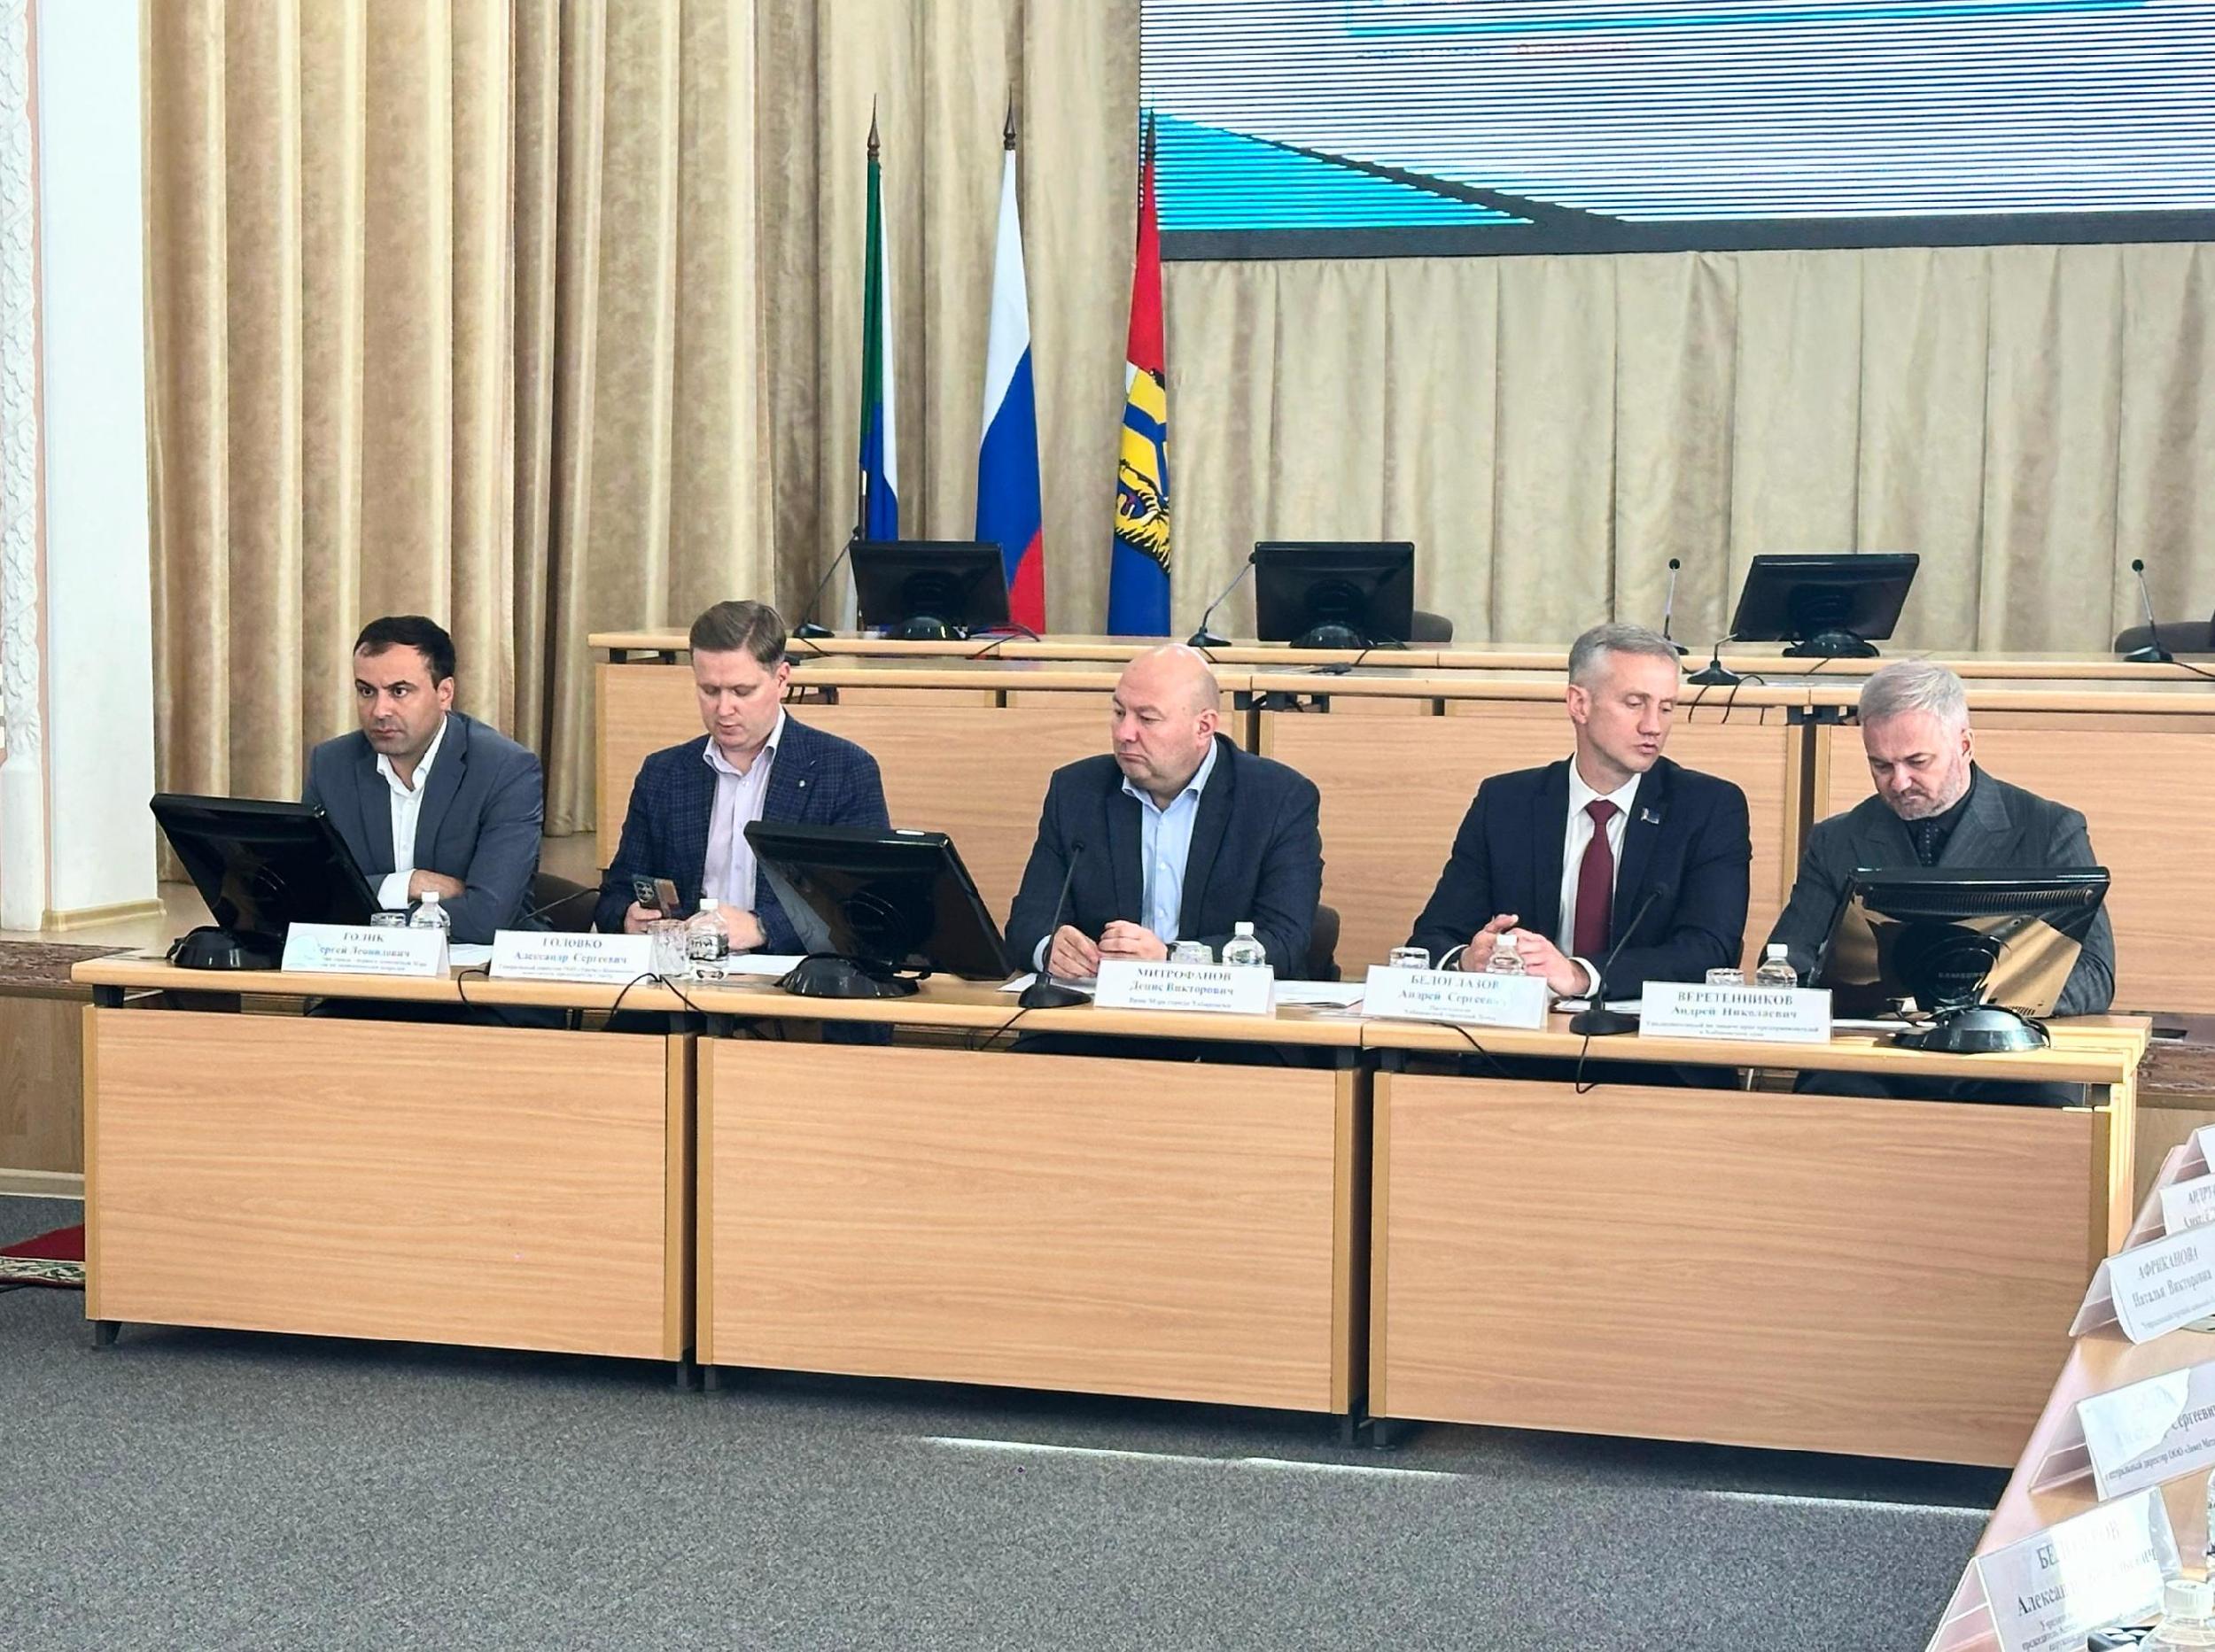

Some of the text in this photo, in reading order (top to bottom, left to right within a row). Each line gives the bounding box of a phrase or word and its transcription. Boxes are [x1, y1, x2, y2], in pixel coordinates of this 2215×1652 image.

[318, 944, 347, 956] ергей
[542, 937, 603, 949] ГОЛОВКО
[1137, 967, 1232, 982] МИТРОФАНОВ
[1411, 974, 1501, 990] БЕЛОГЛАЗОВ
[1129, 980, 1234, 997] Денис Викторович
[1398, 989, 1442, 1003] Андрей
[1677, 991, 1794, 1006] ВЕРЕТЕННИКОВ
[1671, 1005, 1798, 1020] Андрей Николаевич
[2138, 1245, 2198, 1280] АФРИКАНОВА
[2132, 1286, 2165, 1307] Наталья
